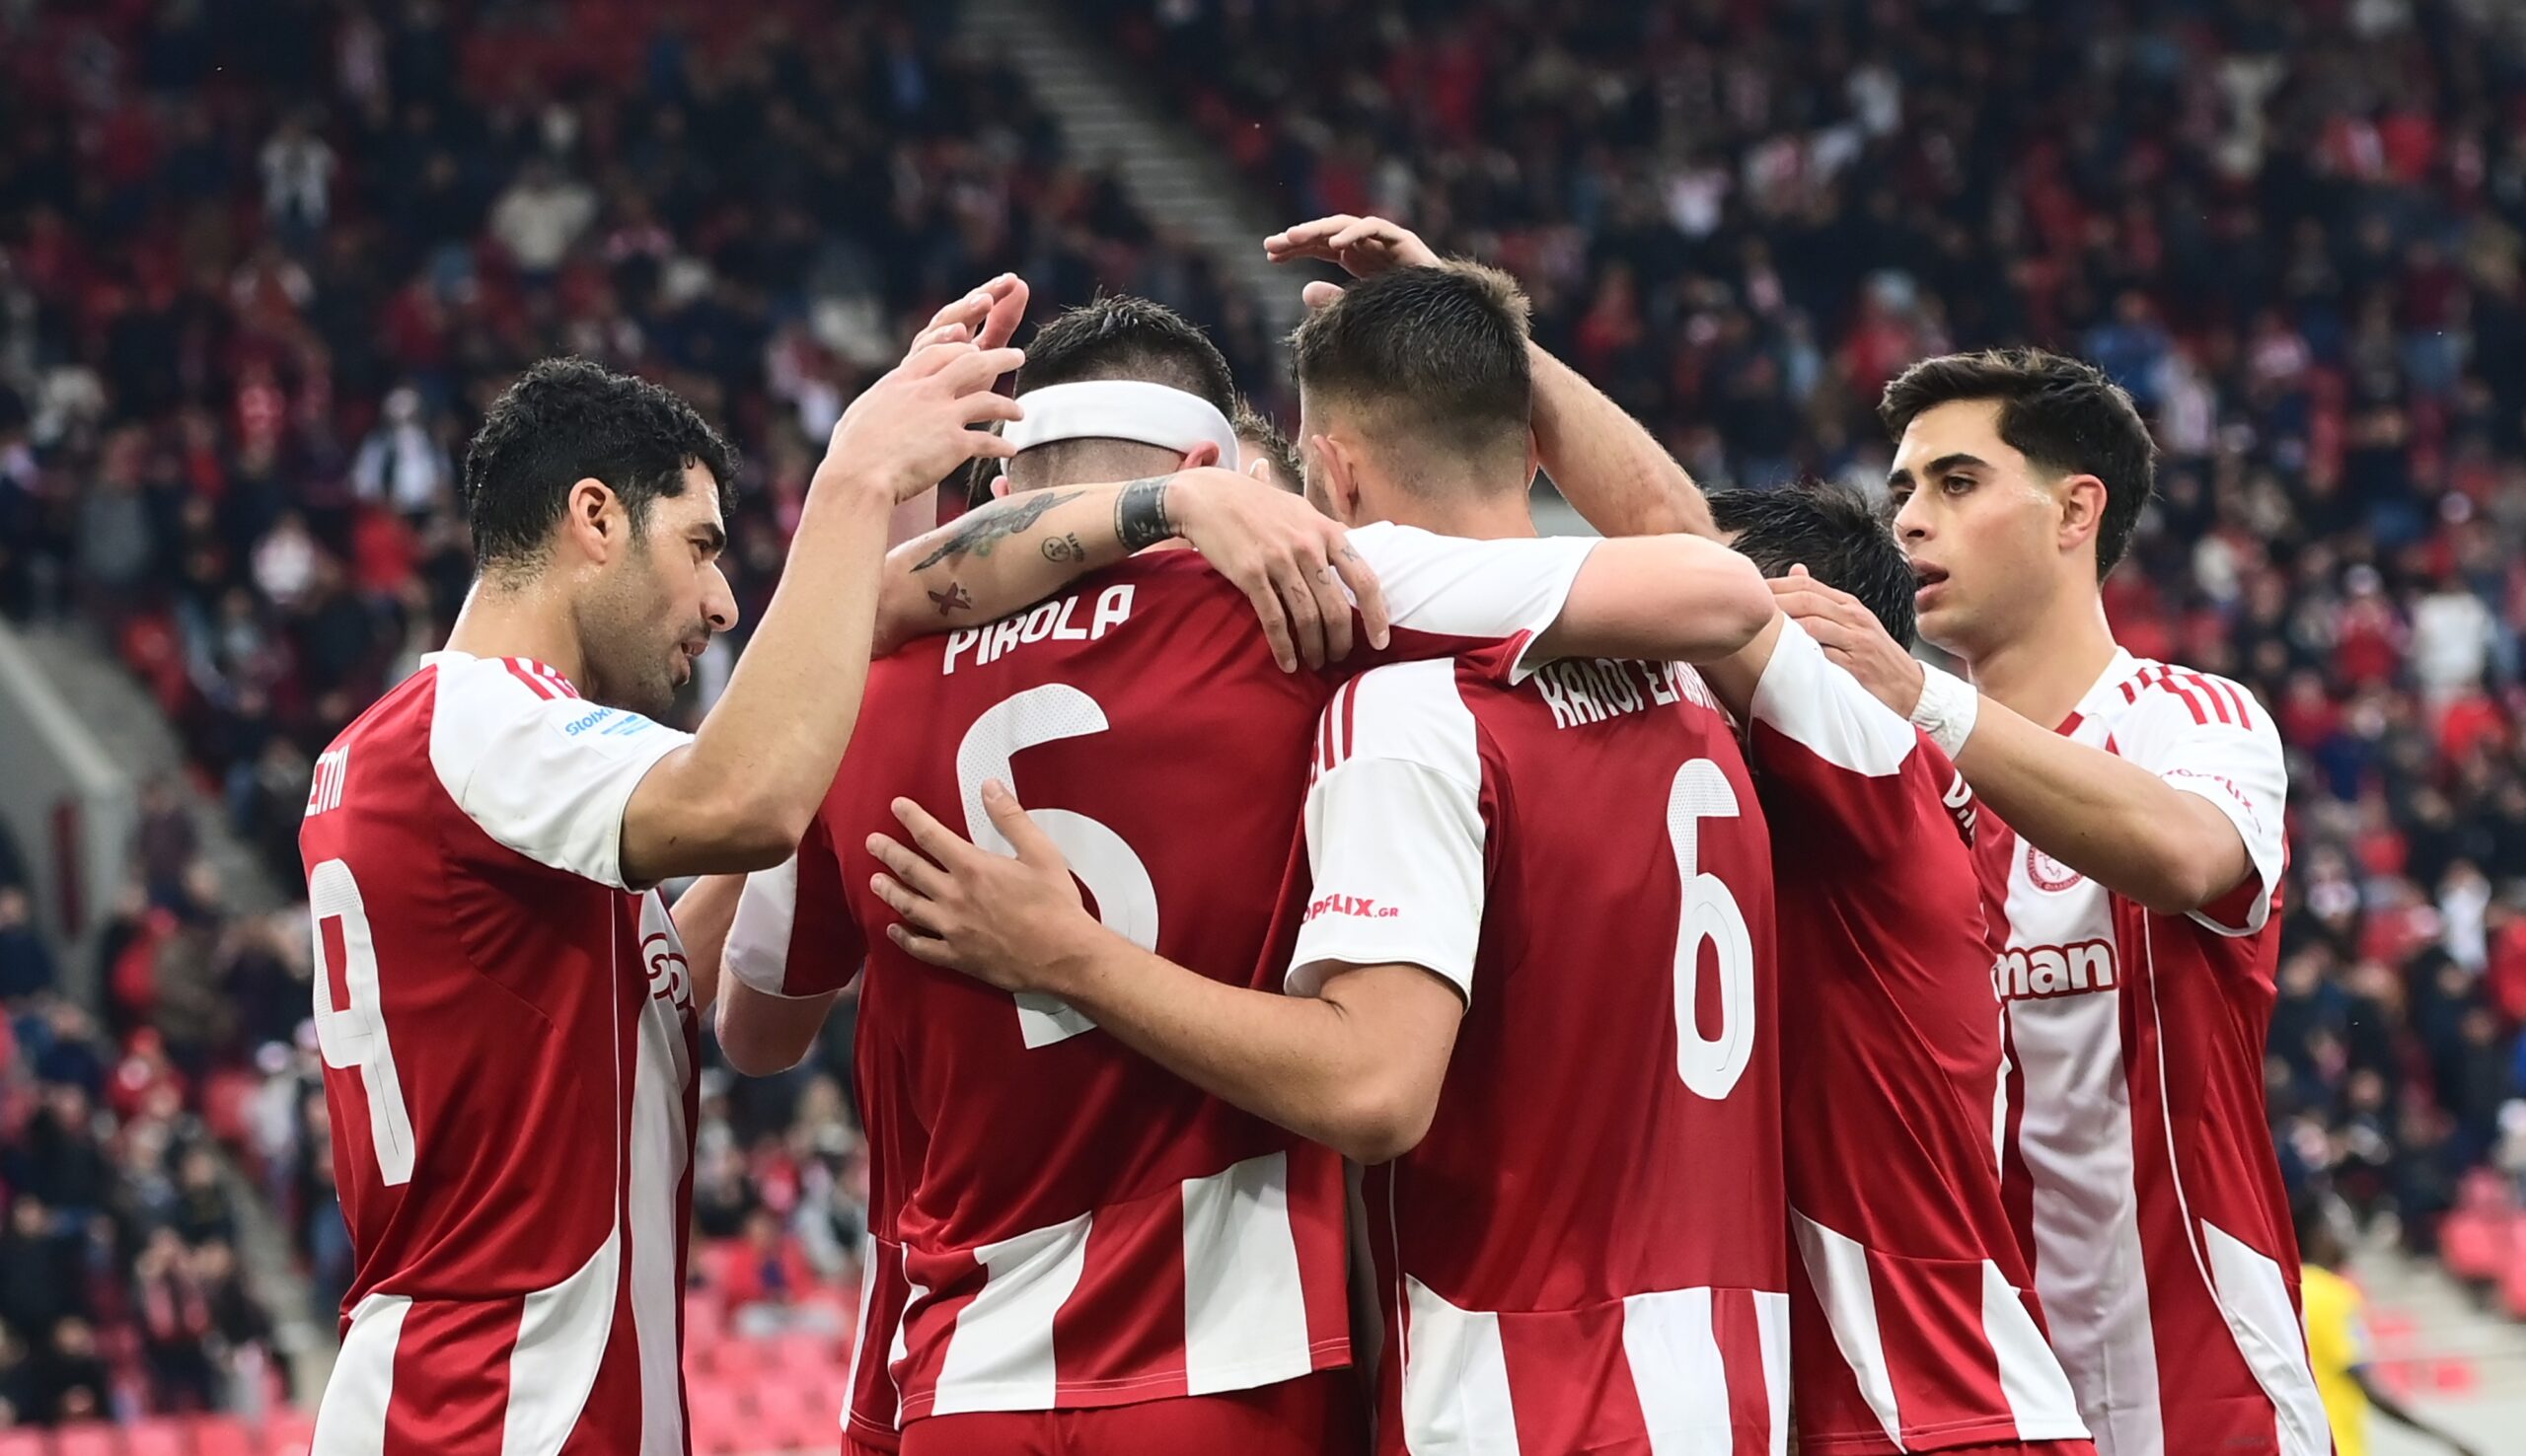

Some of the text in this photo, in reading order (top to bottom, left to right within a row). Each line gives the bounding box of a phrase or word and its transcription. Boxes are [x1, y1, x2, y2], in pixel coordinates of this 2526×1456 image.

[943, 584, 1136, 675] PIROLA
[305, 743, 349, 817] EMI
[1667, 758, 1755, 1101] 6
[1993, 940, 2117, 999] man
[310, 857, 415, 1187] 9
